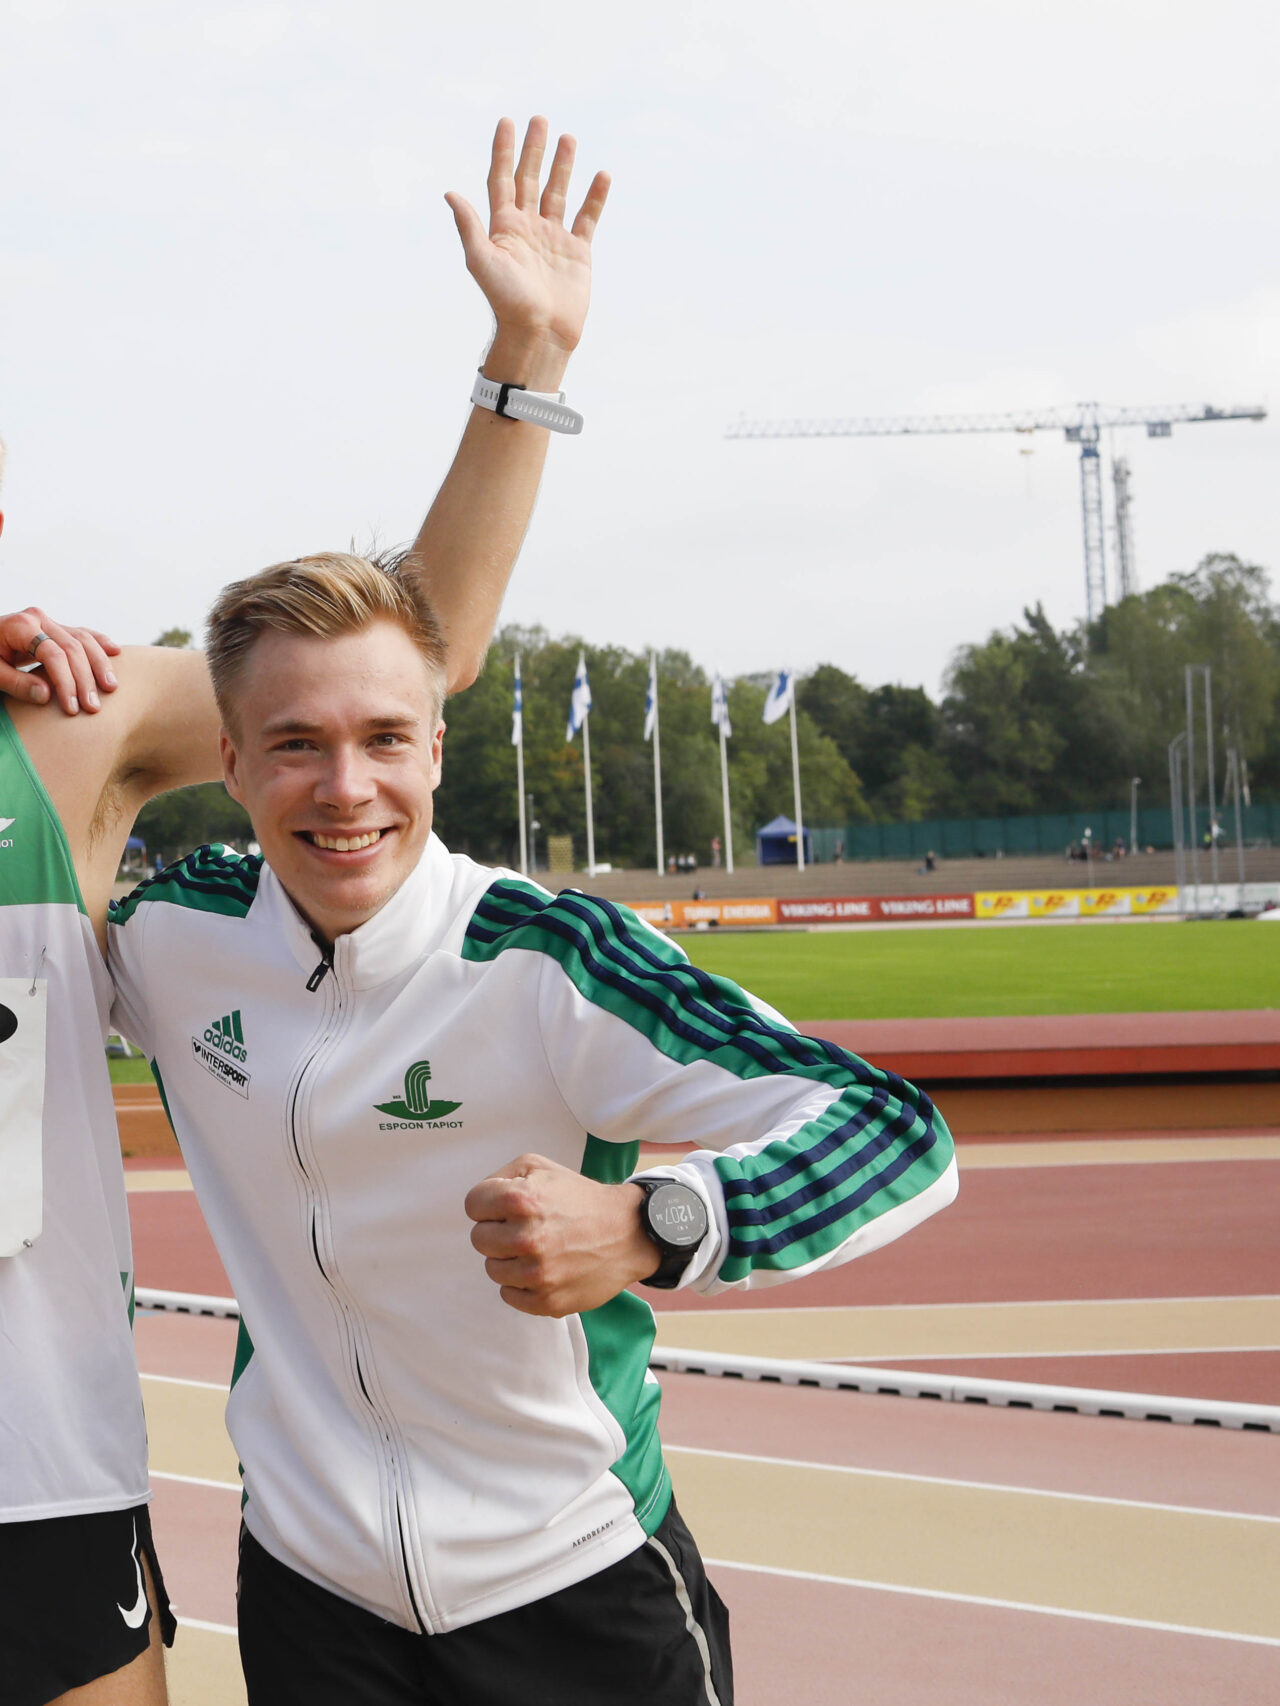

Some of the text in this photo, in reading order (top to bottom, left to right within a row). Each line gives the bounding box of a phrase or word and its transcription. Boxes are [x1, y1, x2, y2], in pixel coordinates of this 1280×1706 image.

[781, 901, 871, 917] VIKING LINE
[880, 900, 934, 915] VIKING
[936, 898, 970, 914] LINE
[204, 1028, 247, 1063] adidas
[201, 1048, 248, 1087] INTERSPORT
[379, 1121, 464, 1131] ESPOON TAPIOT
